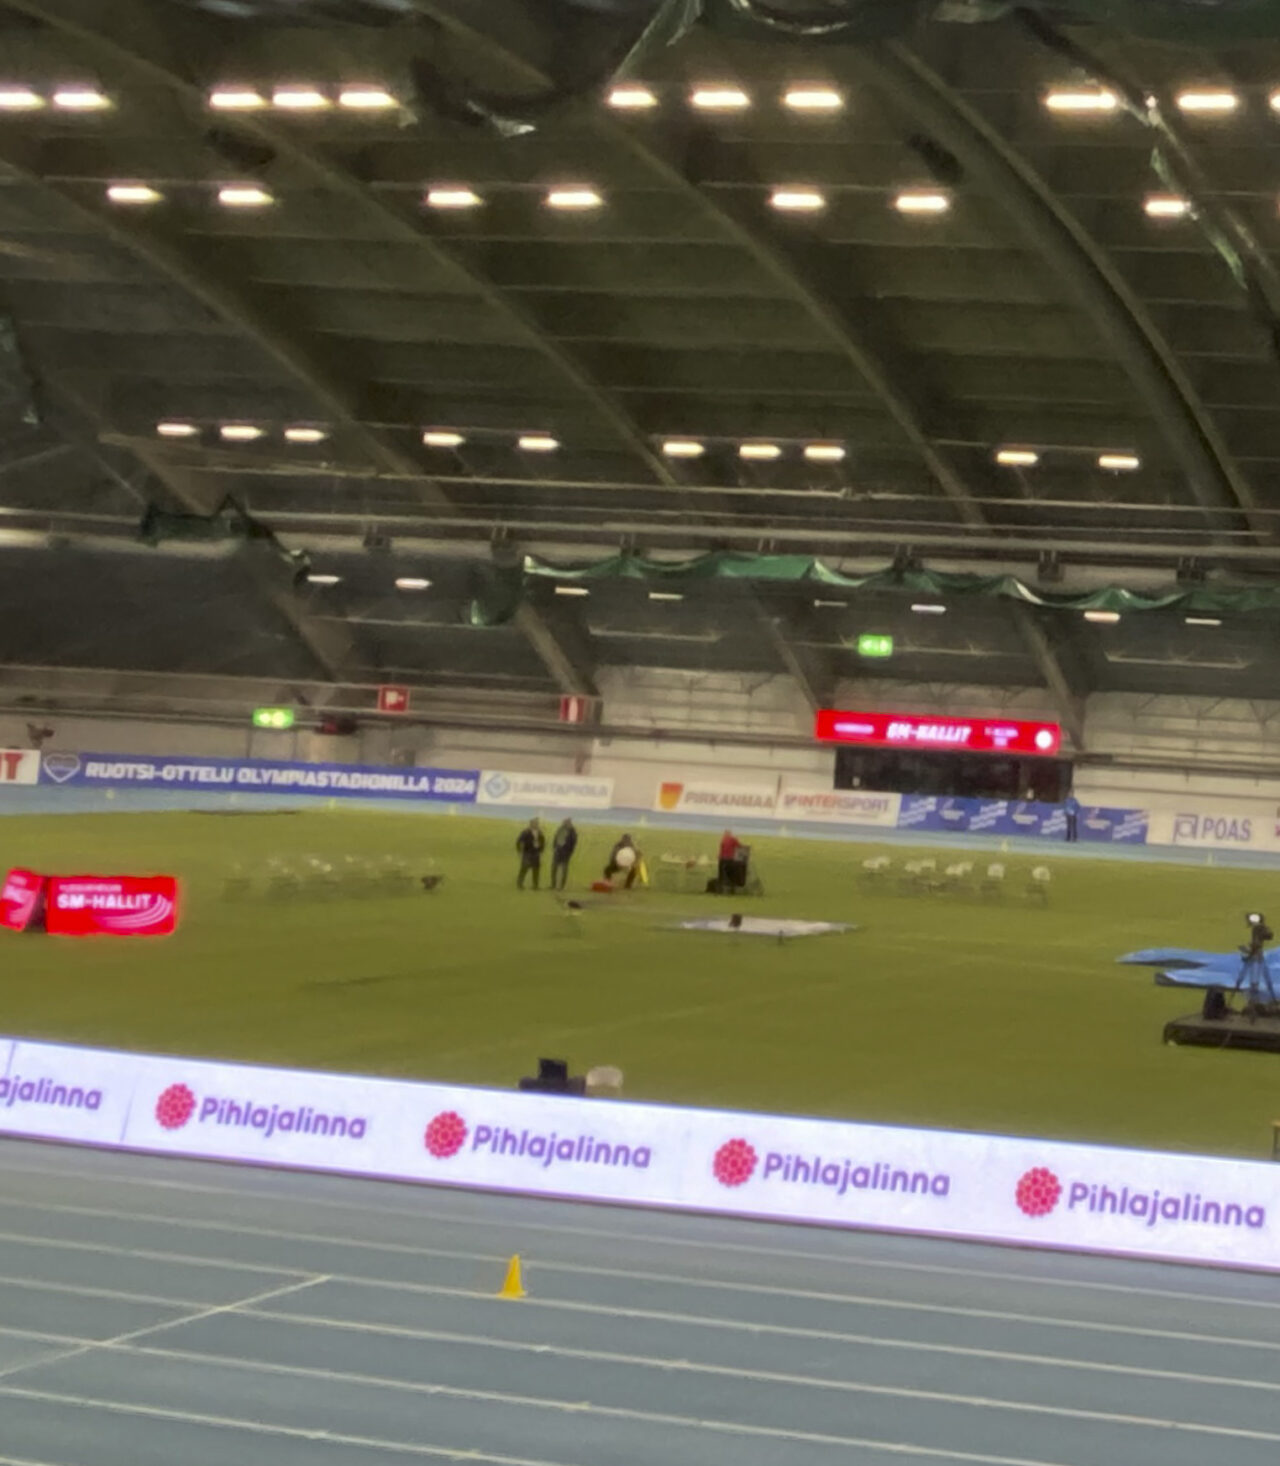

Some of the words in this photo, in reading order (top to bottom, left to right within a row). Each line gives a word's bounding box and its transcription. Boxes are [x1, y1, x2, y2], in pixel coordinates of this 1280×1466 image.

[86, 762, 234, 783] RUOTSI-OTTELU
[237, 767, 429, 792] OLYMPIASTADIONILLA
[434, 777, 475, 793] 2024
[796, 794, 889, 812] INTERSPORT
[1202, 818, 1252, 842] POAS
[57, 893, 152, 909] SM-HALLIT
[198, 1096, 367, 1140] Pihlajalinna
[472, 1125, 652, 1169] Pihlajalinna
[763, 1151, 951, 1197] Pihlajalinna
[1069, 1182, 1266, 1229] Pihlajalinna
